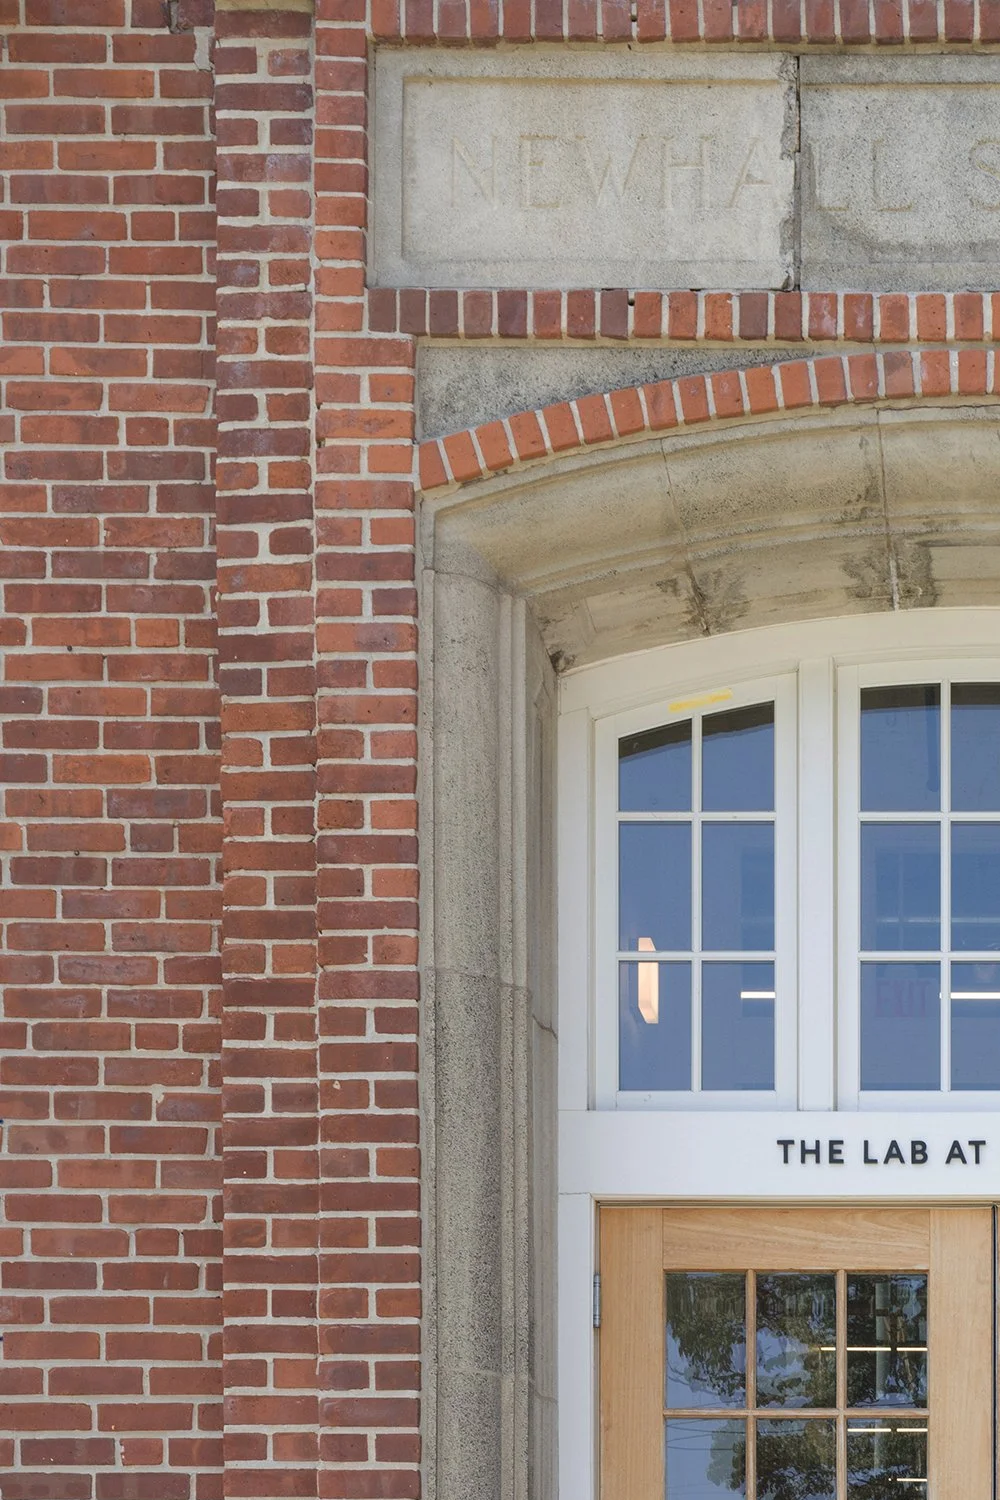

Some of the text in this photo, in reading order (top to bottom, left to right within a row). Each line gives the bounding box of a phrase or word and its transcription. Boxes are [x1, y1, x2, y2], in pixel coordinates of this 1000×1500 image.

[776, 1139, 845, 1165] THE
[863, 1139, 929, 1165] LAB
[945, 1139, 987, 1165] AT
